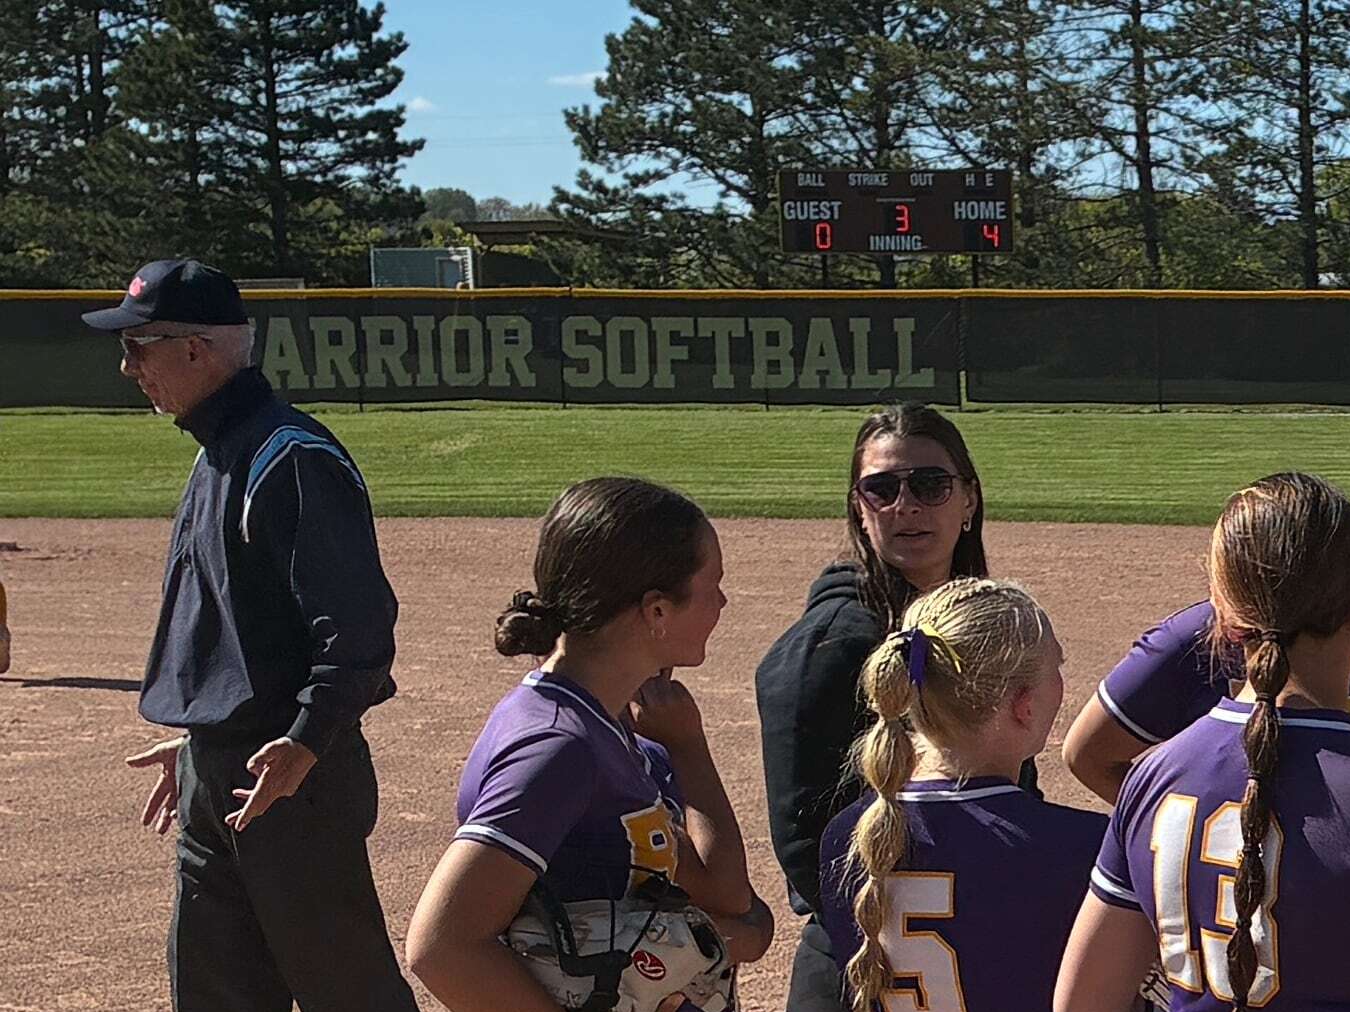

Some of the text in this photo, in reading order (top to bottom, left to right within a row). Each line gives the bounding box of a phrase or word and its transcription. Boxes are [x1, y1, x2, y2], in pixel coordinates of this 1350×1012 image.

[797, 173, 994, 187] BALL STRIKE OUT H E
[783, 201, 842, 220] GUEST
[895, 204, 911, 232] 3
[954, 201, 1007, 220] HOME
[815, 222, 832, 249] 0
[869, 235, 923, 251] INNING
[982, 224, 999, 248] 4
[250, 315, 936, 391] ARRIOR SOFTBALL
[1150, 792, 1286, 1008] 13
